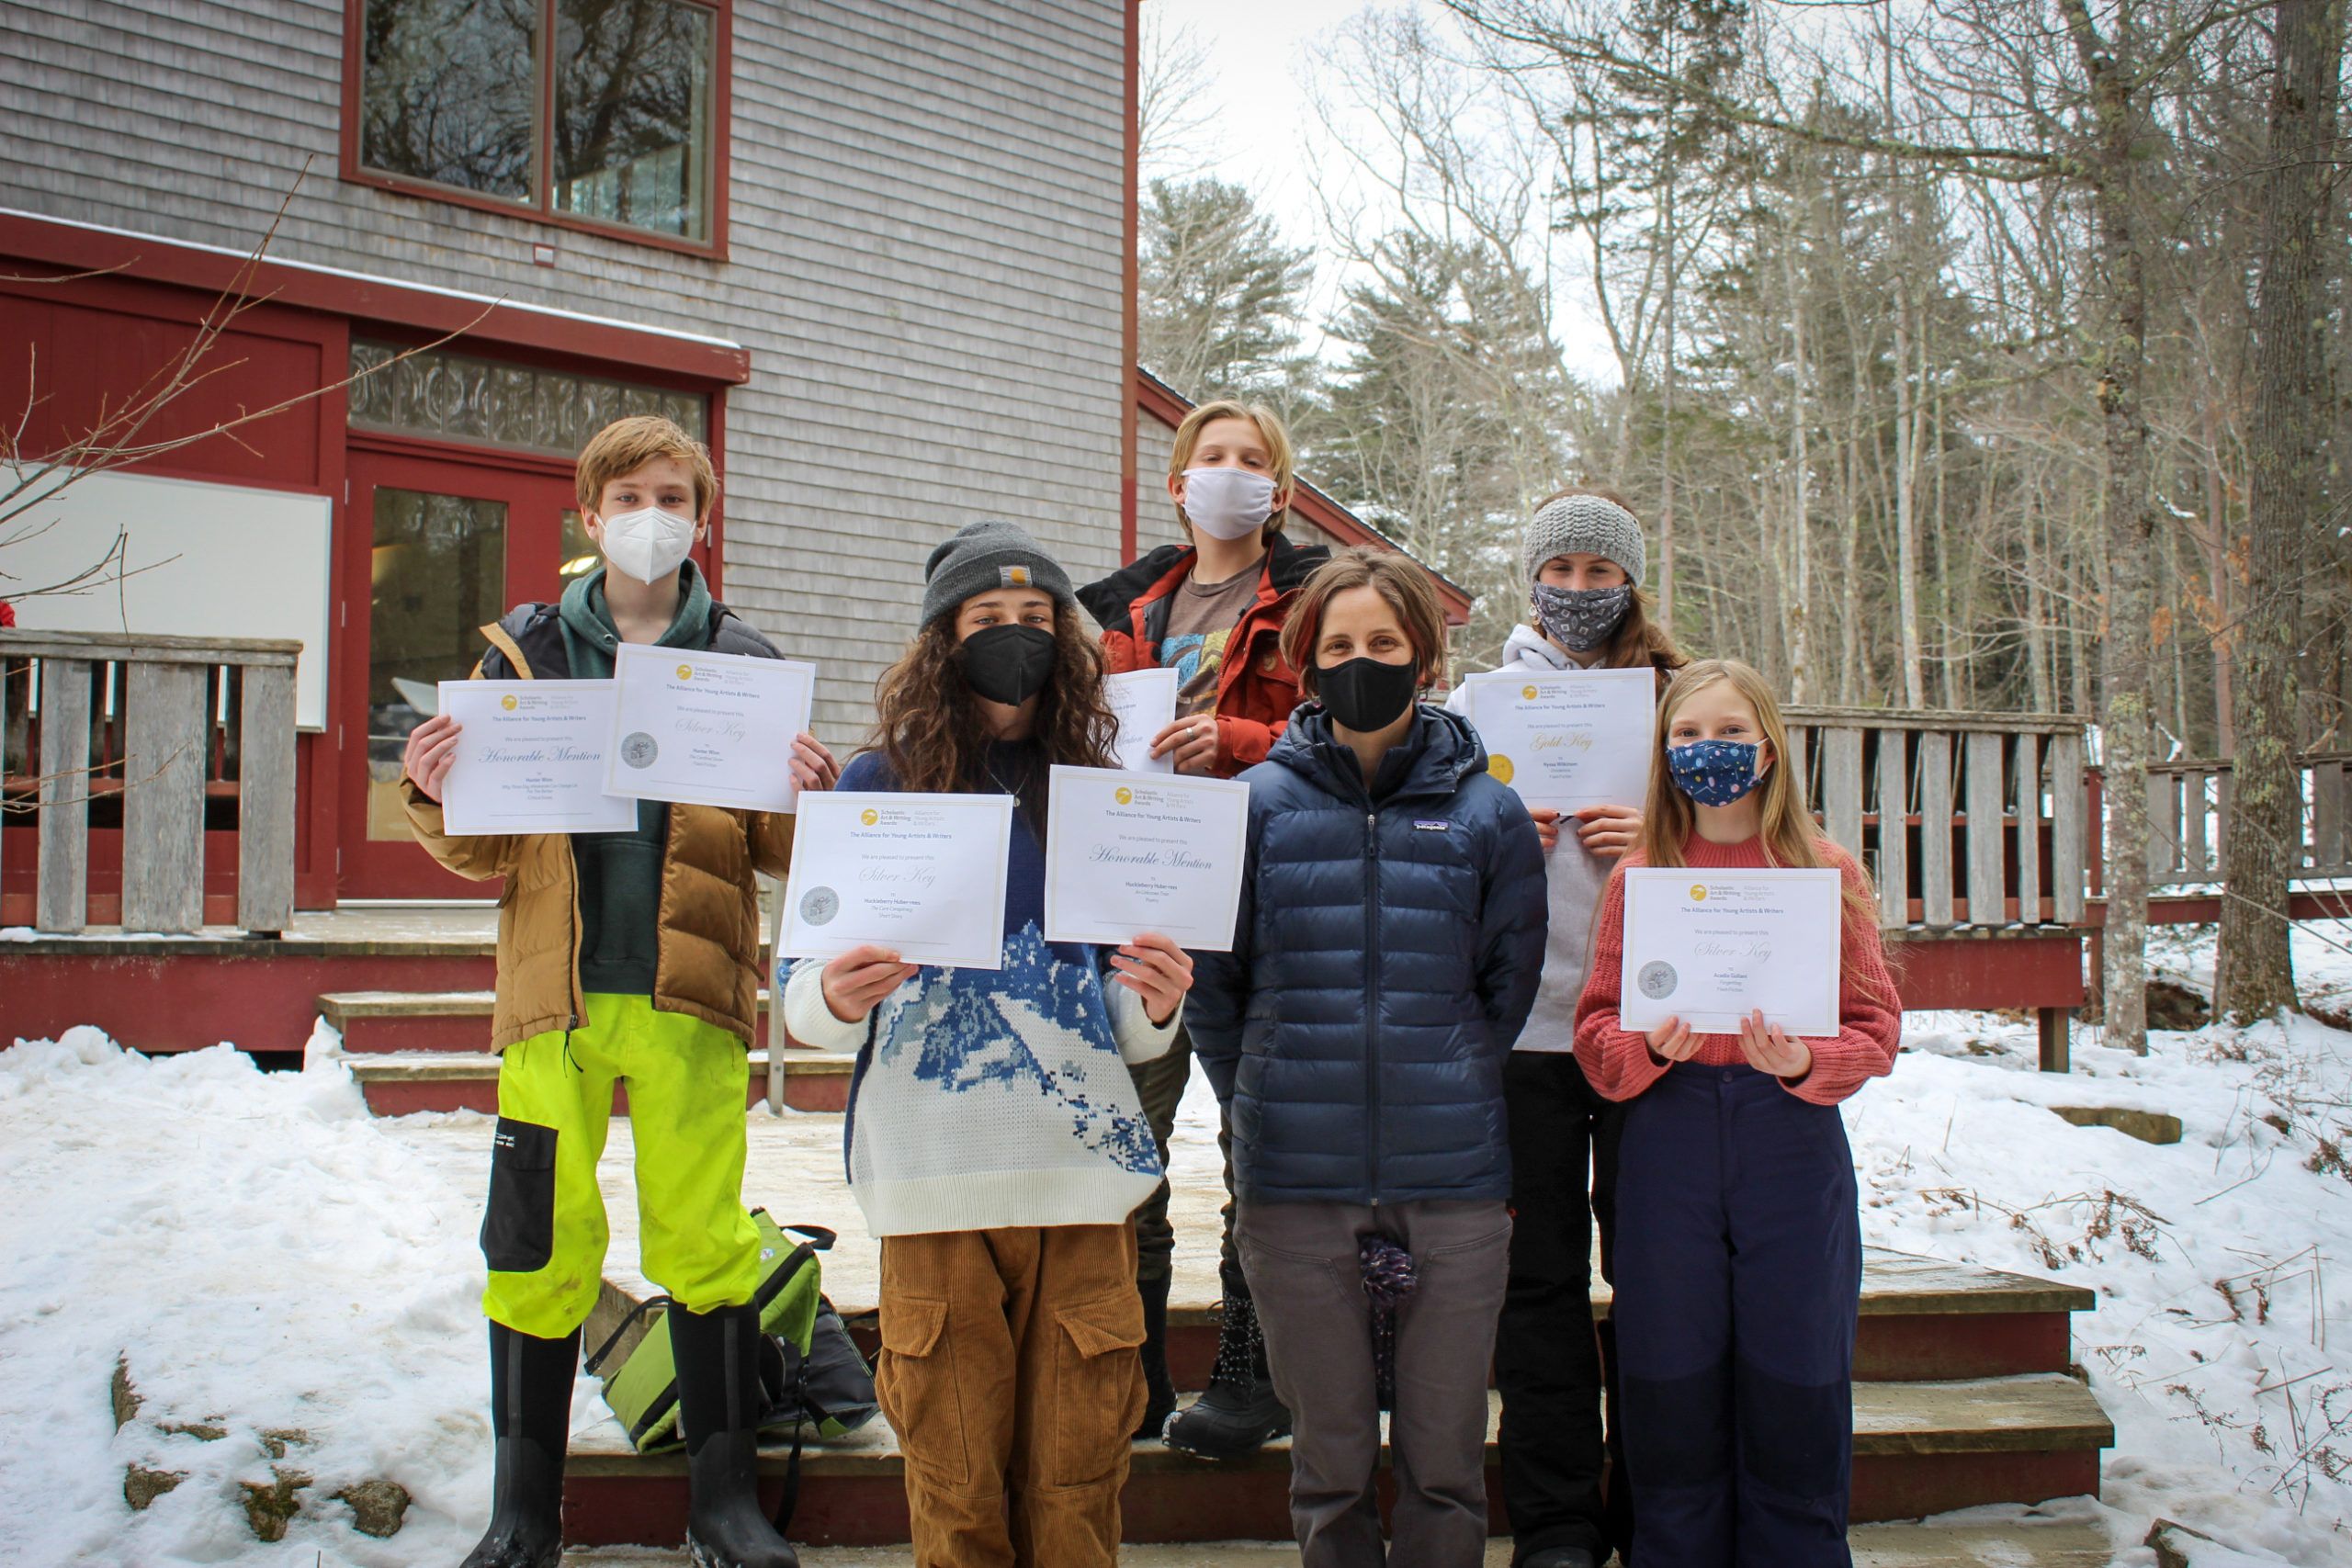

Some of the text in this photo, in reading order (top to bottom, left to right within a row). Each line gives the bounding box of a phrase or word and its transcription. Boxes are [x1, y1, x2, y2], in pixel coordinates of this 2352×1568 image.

[674, 718, 746, 742] Silver Key
[478, 746, 601, 762] Honorable Mention
[1530, 732, 1593, 753] Gold Key
[1089, 843, 1212, 869] Honorable Mention
[859, 865, 935, 889] Silver Key
[1694, 941, 1771, 964] Silver Key
